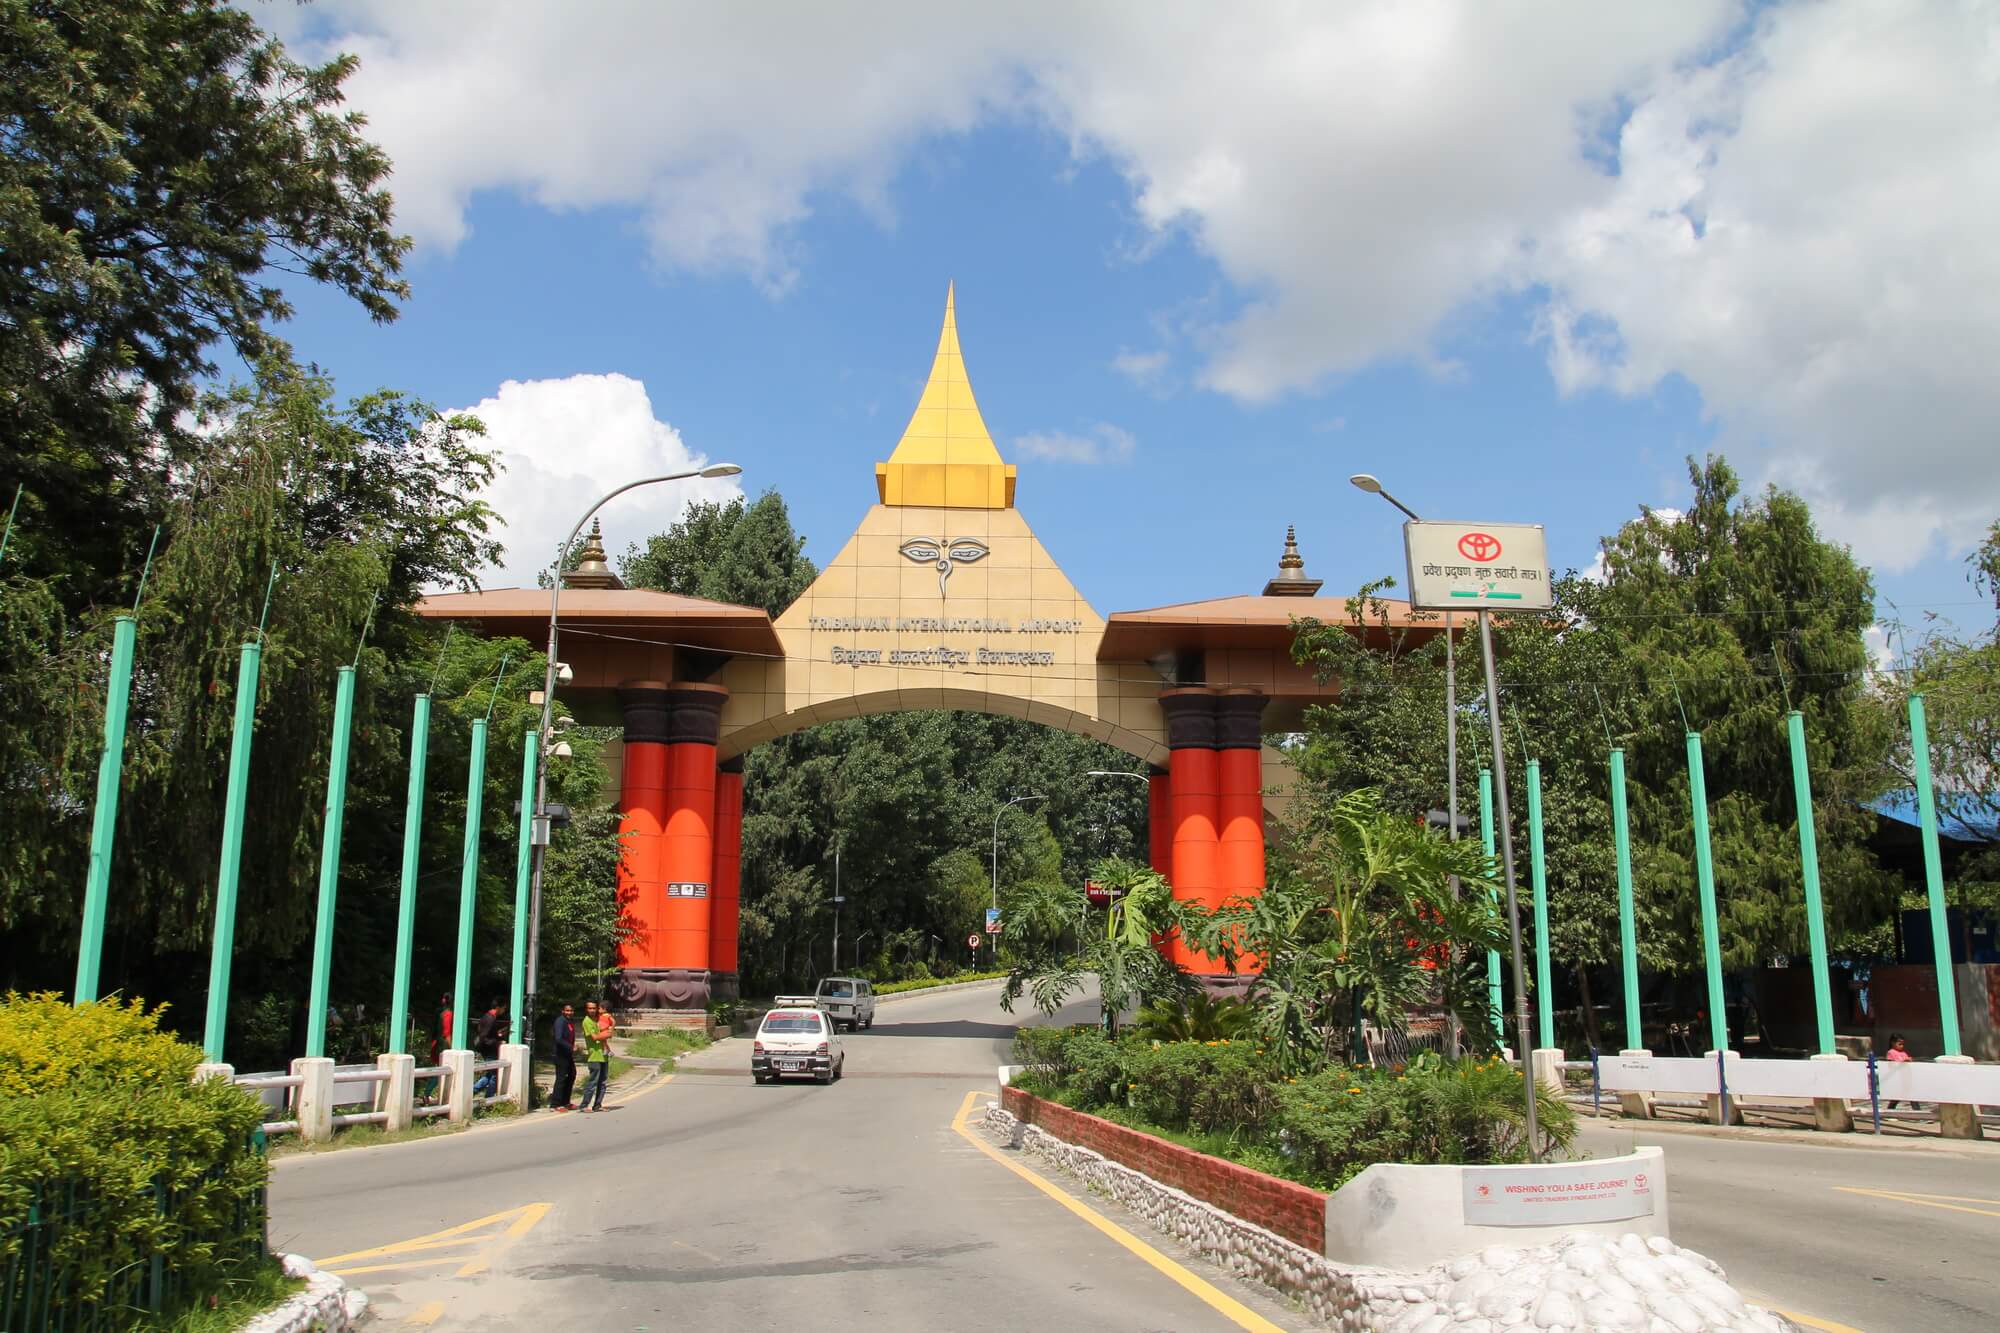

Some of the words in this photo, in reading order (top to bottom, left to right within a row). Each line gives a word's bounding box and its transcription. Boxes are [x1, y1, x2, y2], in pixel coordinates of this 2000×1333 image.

[809, 616, 890, 632] TRIBHUVAN
[895, 617, 1012, 634] INTERNATIONAL
[1016, 619, 1082, 635] AIRPORT
[1504, 1185, 1545, 1193] WISHING
[1547, 1184, 1566, 1193] YOU
[1567, 1183, 1573, 1191] A
[1574, 1182, 1595, 1191] SAFE
[1596, 1179, 1628, 1190] JOURNEY
